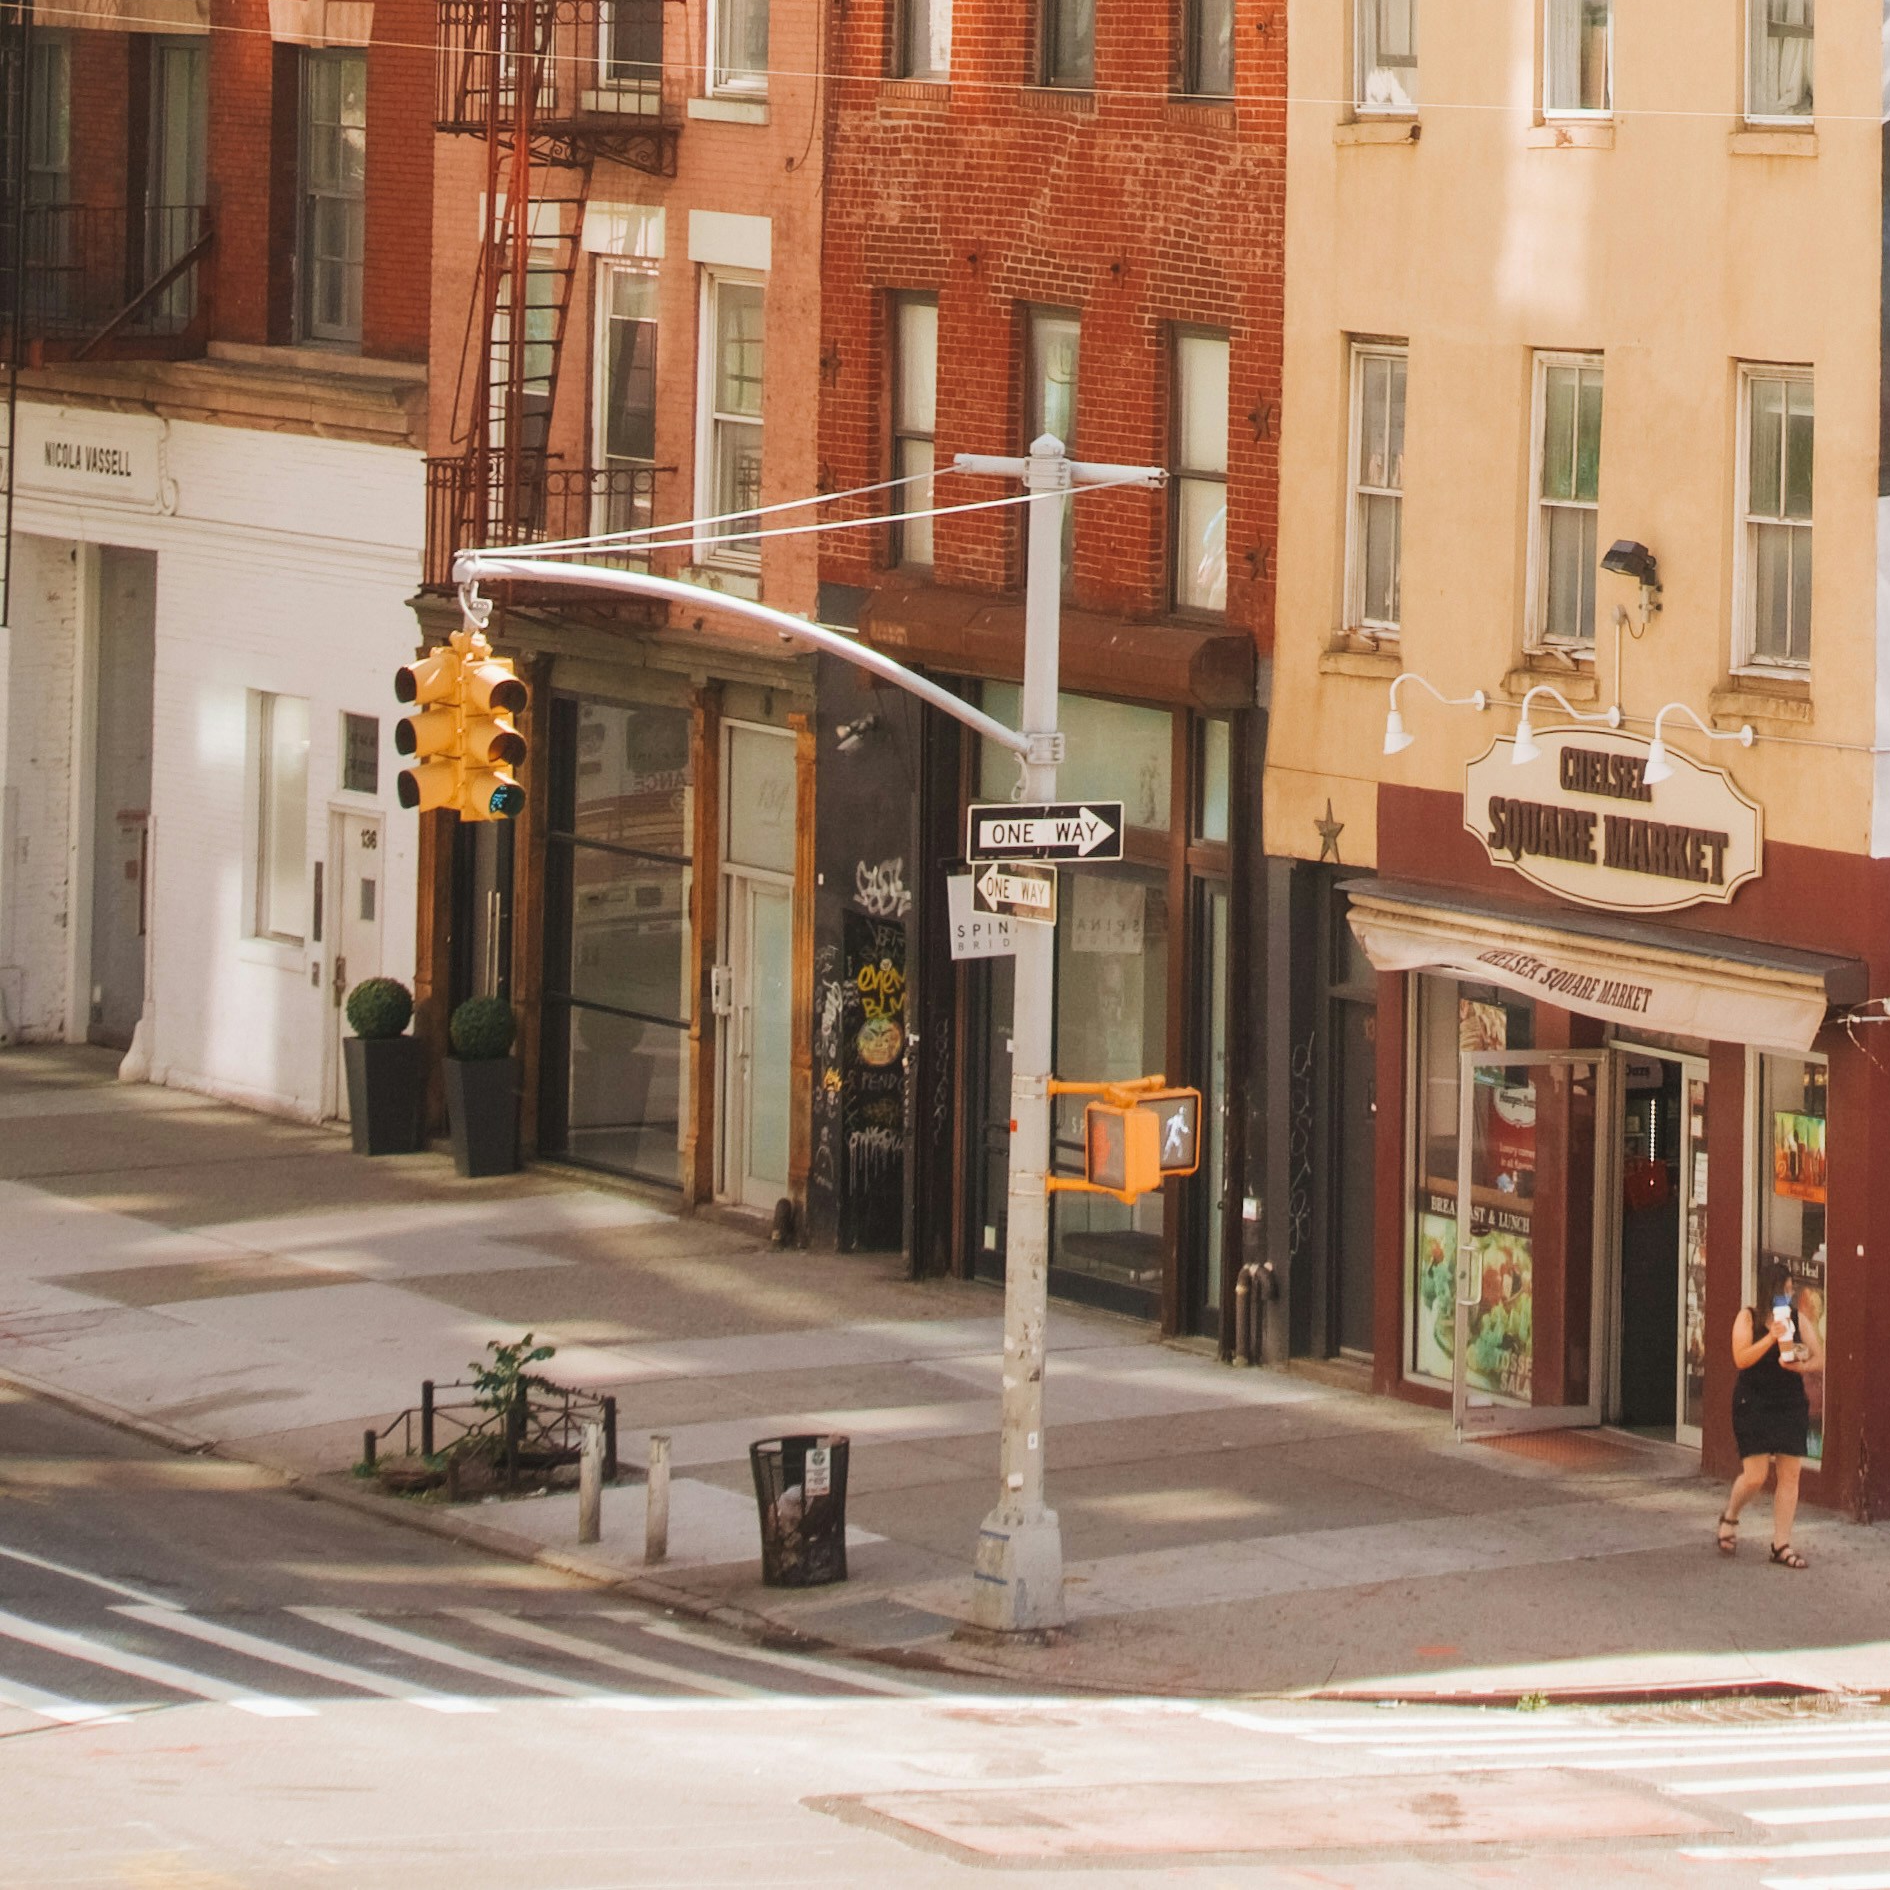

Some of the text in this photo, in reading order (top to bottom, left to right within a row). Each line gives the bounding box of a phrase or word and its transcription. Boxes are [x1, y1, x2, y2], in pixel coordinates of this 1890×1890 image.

[44, 440, 132, 477] NICOLA VASSELL
[992, 821, 1099, 844] ONE WAY
[1487, 795, 1729, 886] SQUARE MARKET
[986, 876, 1045, 901] ONE WAY
[1476, 949, 1653, 1014] CHELSEA SQUARE MARKET
[1488, 1210, 1496, 1225] &
[1499, 1213, 1530, 1233] LUNCH
